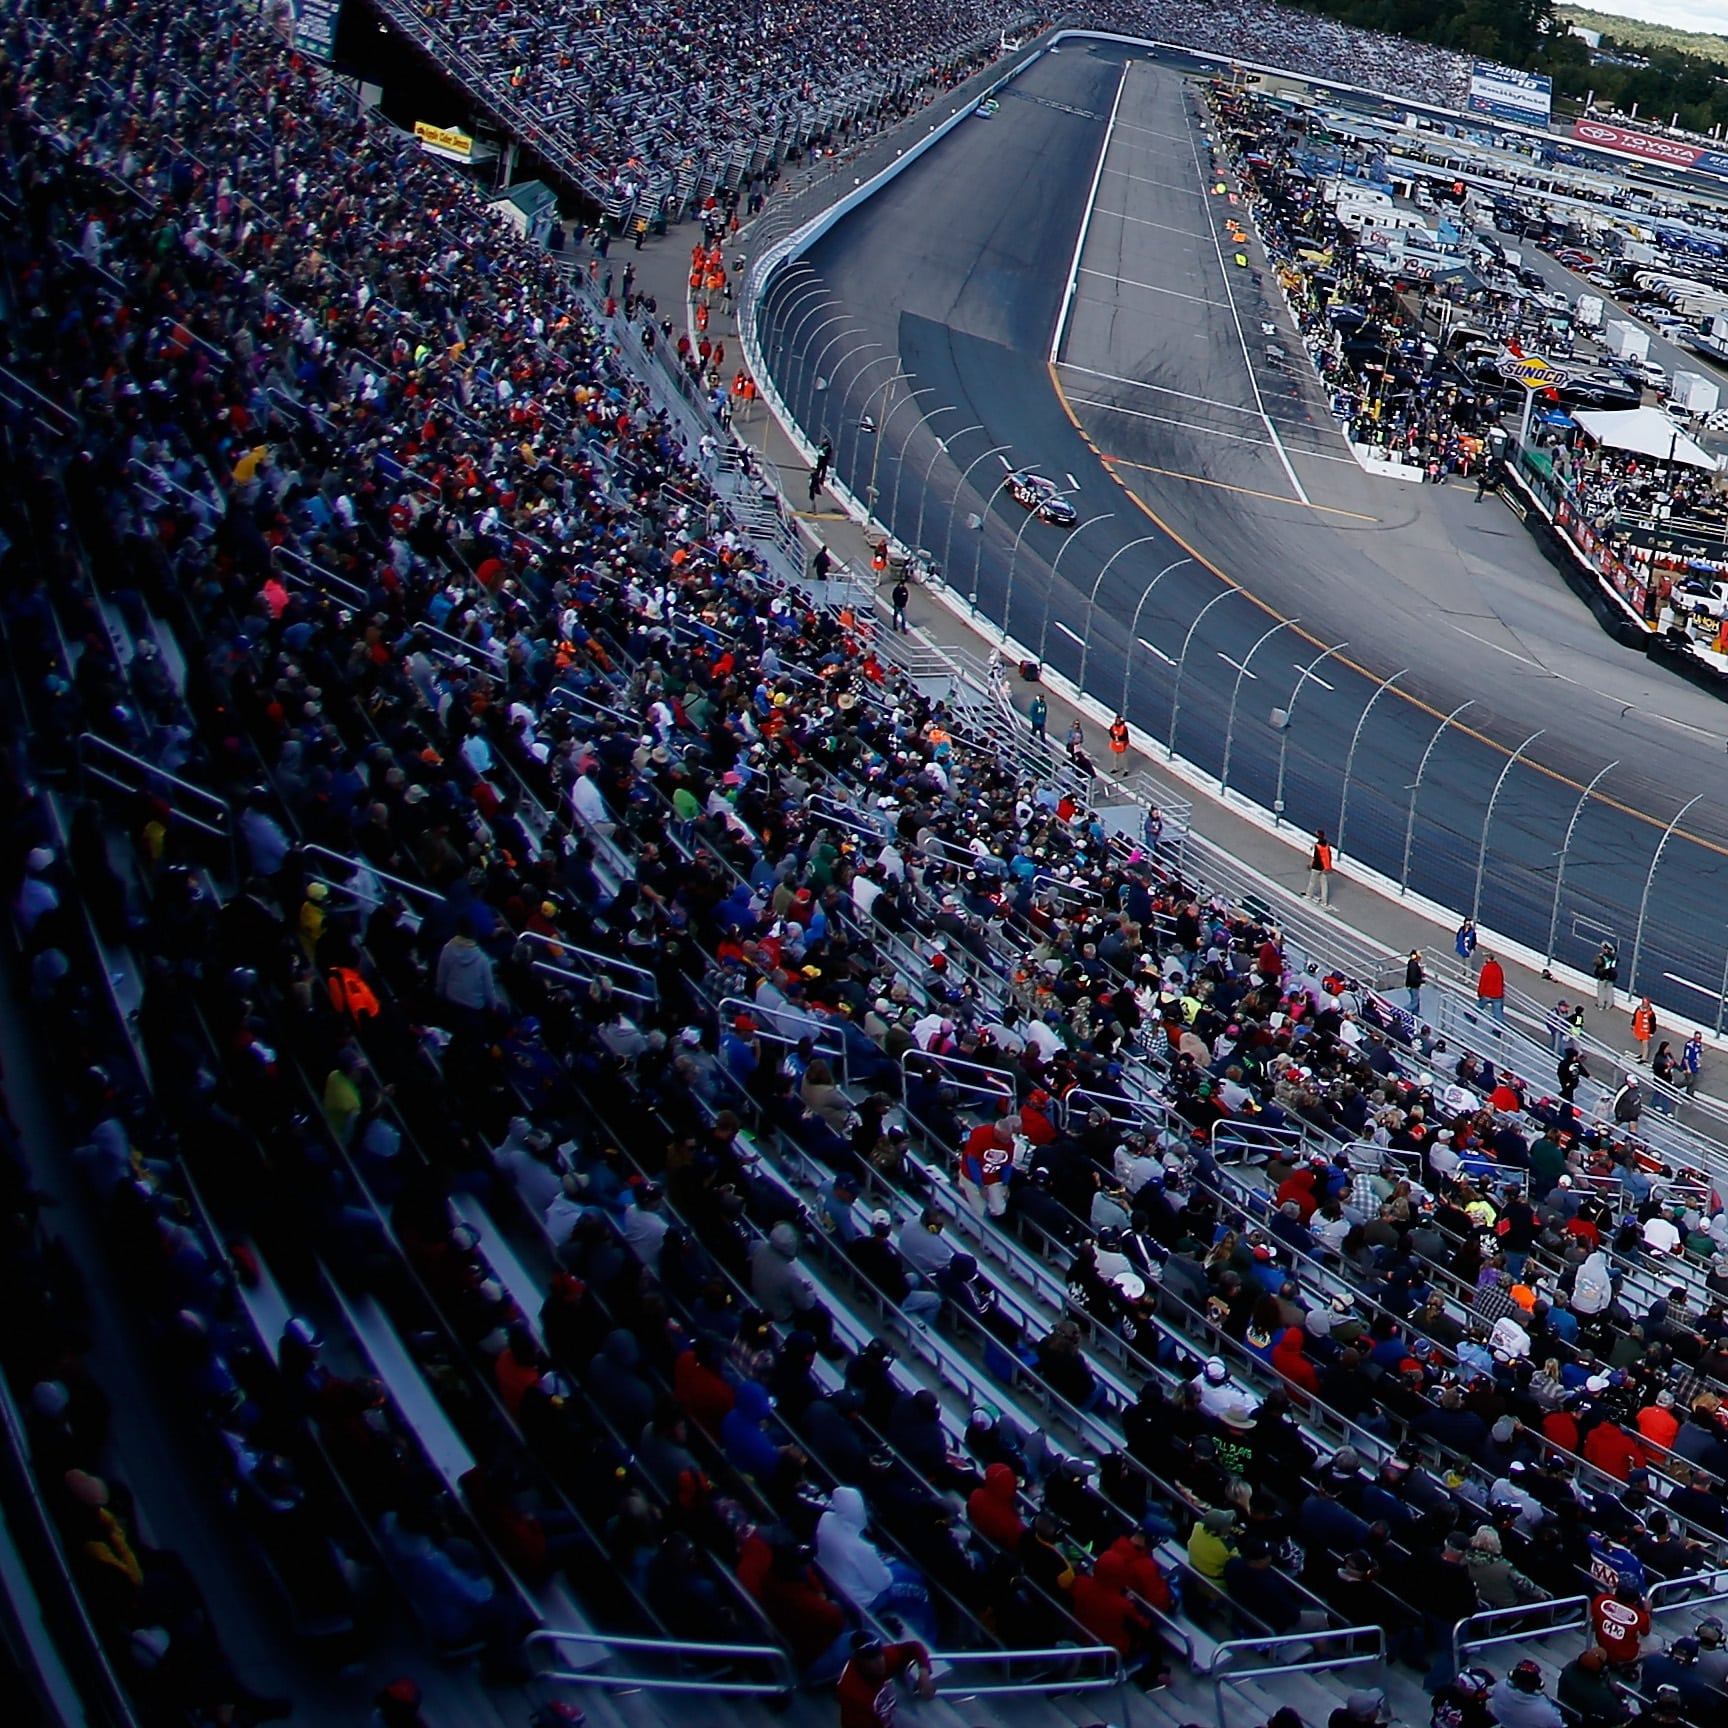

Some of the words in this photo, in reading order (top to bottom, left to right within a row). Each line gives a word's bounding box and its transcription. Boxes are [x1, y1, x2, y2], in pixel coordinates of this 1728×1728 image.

[1621, 134, 1695, 158] TOYOTA
[1505, 363, 1568, 384] SUNOCO
[1692, 613, 1720, 630] UNOH
